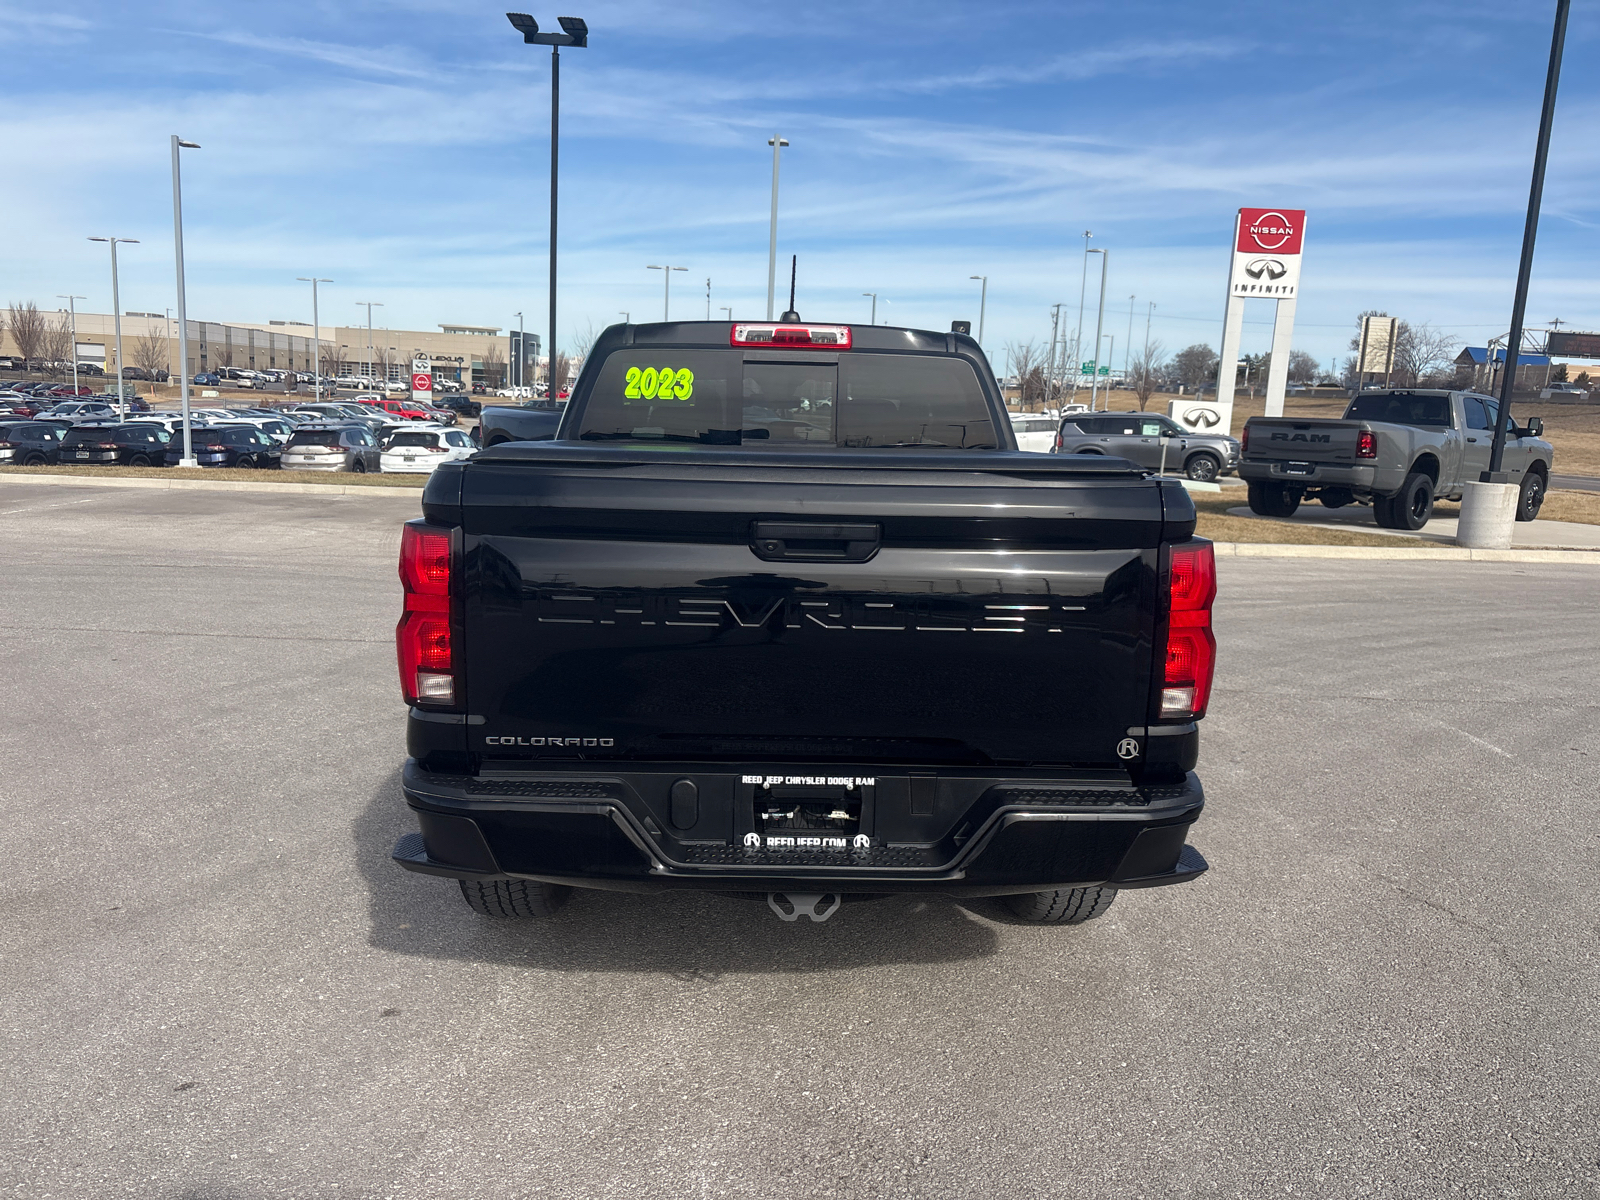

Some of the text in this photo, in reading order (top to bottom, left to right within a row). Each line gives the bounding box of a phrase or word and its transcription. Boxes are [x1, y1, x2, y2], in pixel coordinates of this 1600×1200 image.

[1250, 226, 1293, 235] NISSAN
[1234, 284, 1294, 295] INFINITI
[624, 366, 694, 401] 2023
[1271, 432, 1331, 443] RAM
[485, 736, 615, 747] COLORADO
[742, 775, 875, 787] REED JEEP CHRYSLER DODGE RAM
